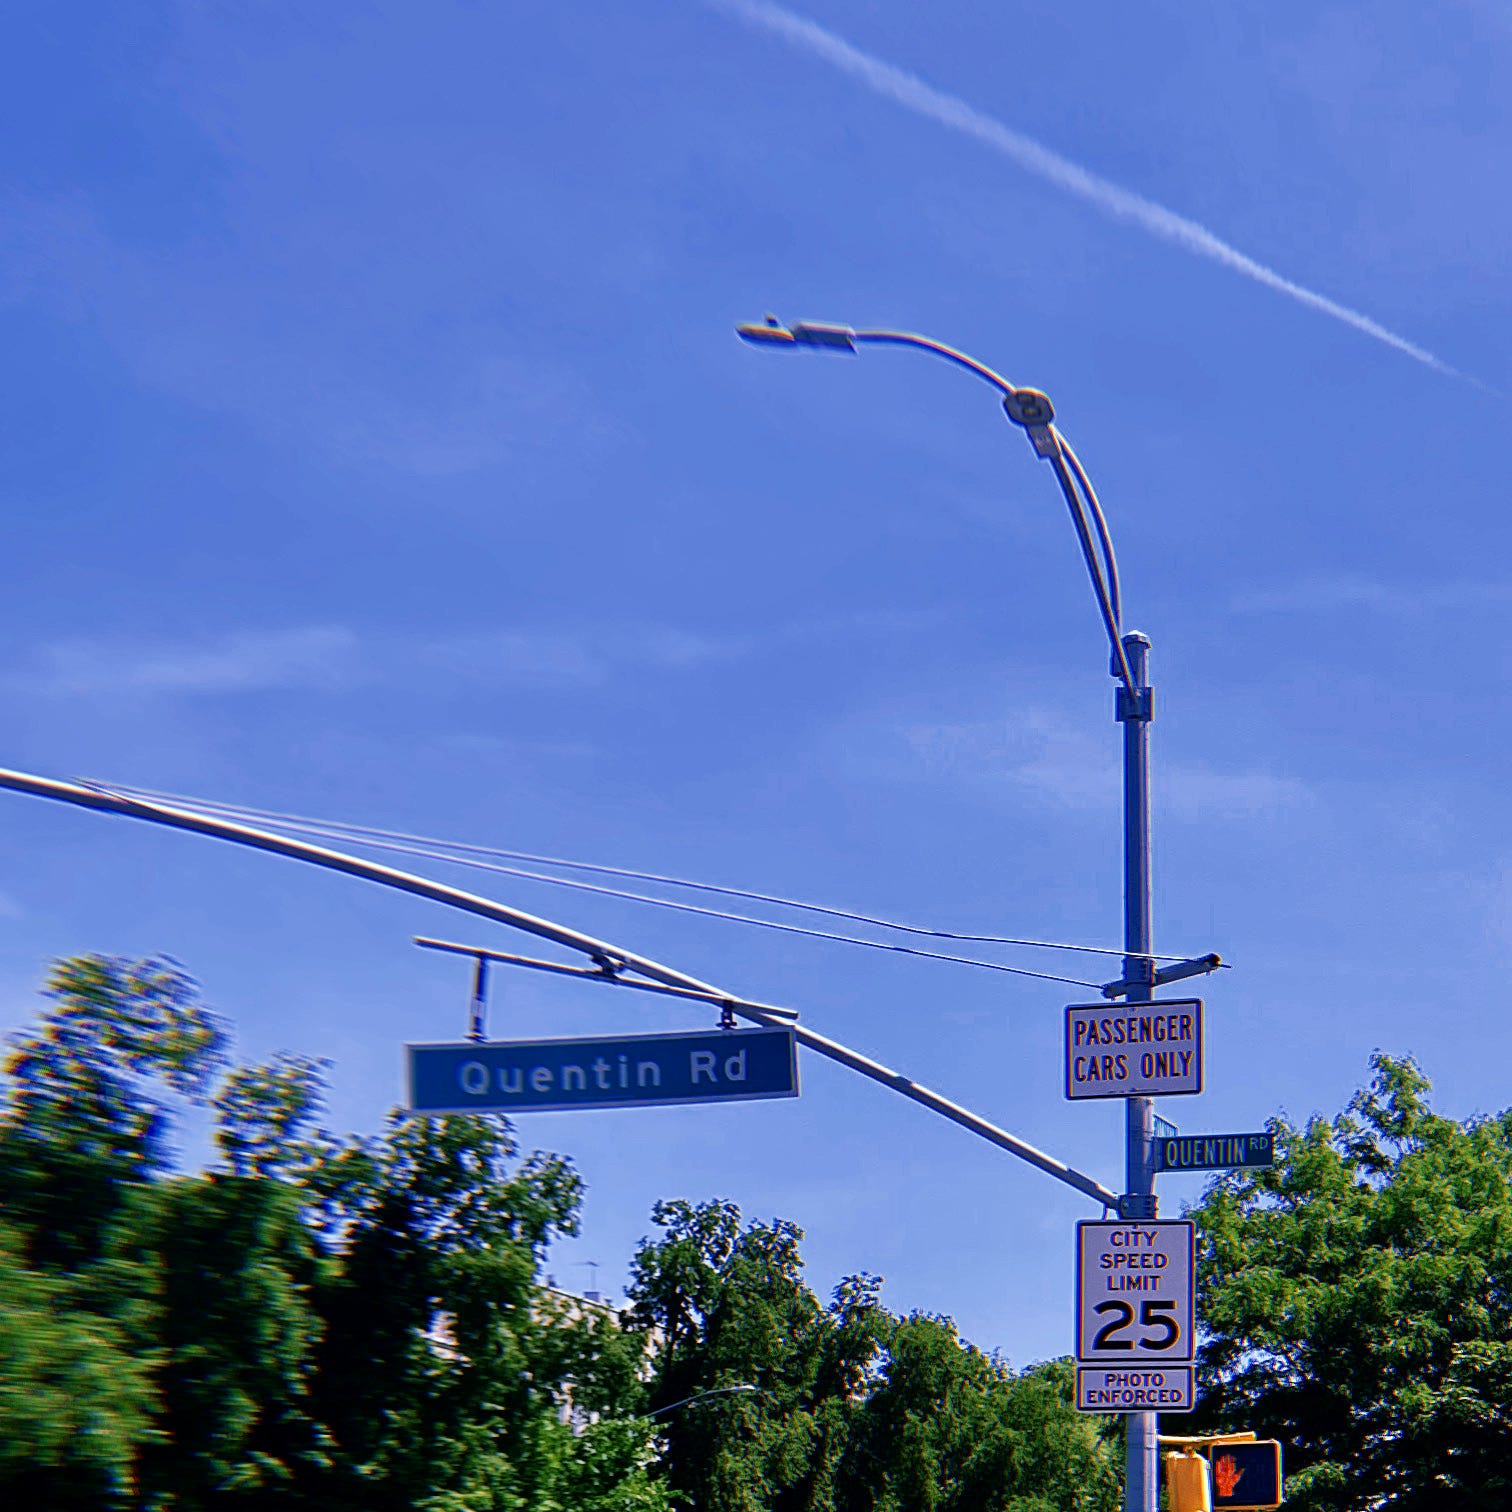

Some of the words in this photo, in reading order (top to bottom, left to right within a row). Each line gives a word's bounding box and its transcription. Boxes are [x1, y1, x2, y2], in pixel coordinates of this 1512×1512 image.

[1074, 1014, 1193, 1046] PASSENGER
[459, 1055, 661, 1095] Quentin
[690, 1049, 747, 1084] Rd
[1074, 1054, 1128, 1082] CARS
[1141, 1050, 1193, 1078] ONLY
[1166, 1137, 1246, 1166] QUENTIN
[1249, 1136, 1268, 1150] RD
[1110, 1231, 1159, 1246] CITY
[1100, 1253, 1169, 1269] SPEED
[1107, 1275, 1162, 1291] LIMIT
[1092, 1300, 1181, 1351] 25
[1104, 1373, 1165, 1387] PHOTO
[1086, 1390, 1184, 1404] ENFORCED
